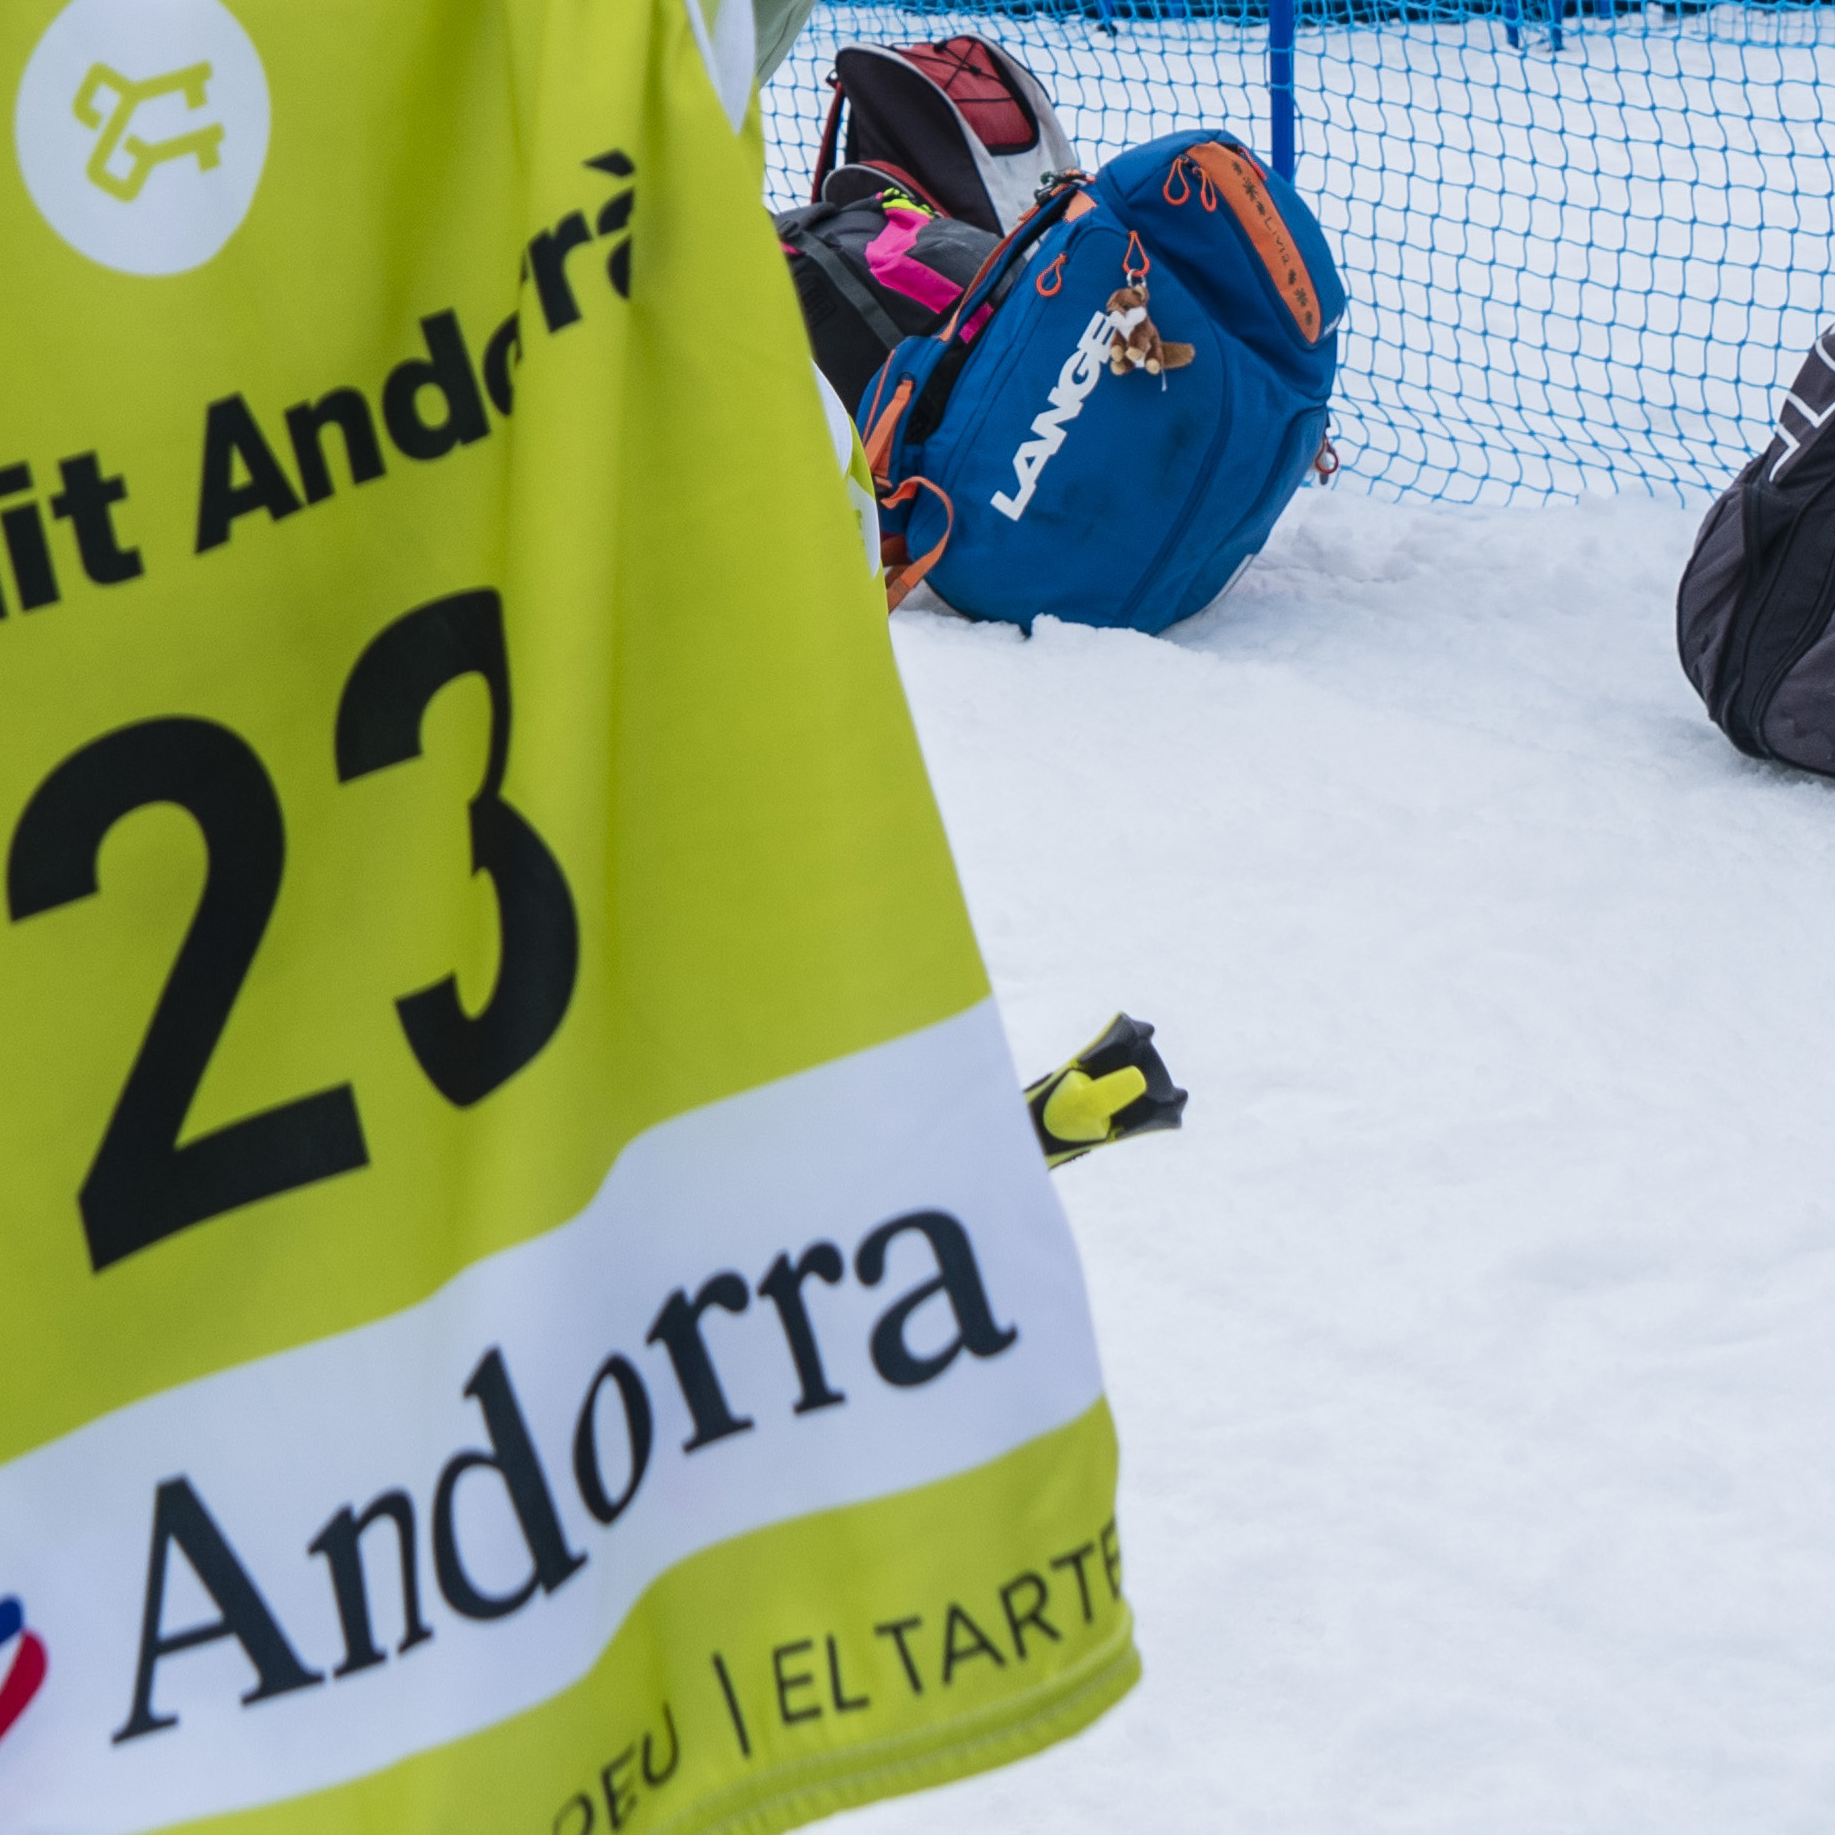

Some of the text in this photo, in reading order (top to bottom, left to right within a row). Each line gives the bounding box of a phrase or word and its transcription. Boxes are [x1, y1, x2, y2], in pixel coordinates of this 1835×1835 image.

[990, 310, 1115, 523] LANGE
[6, 586, 580, 1276] 23
[110, 1207, 1020, 1749] Andorra
[773, 1634, 869, 1728] EL
[874, 1515, 1122, 1696] TARTE
